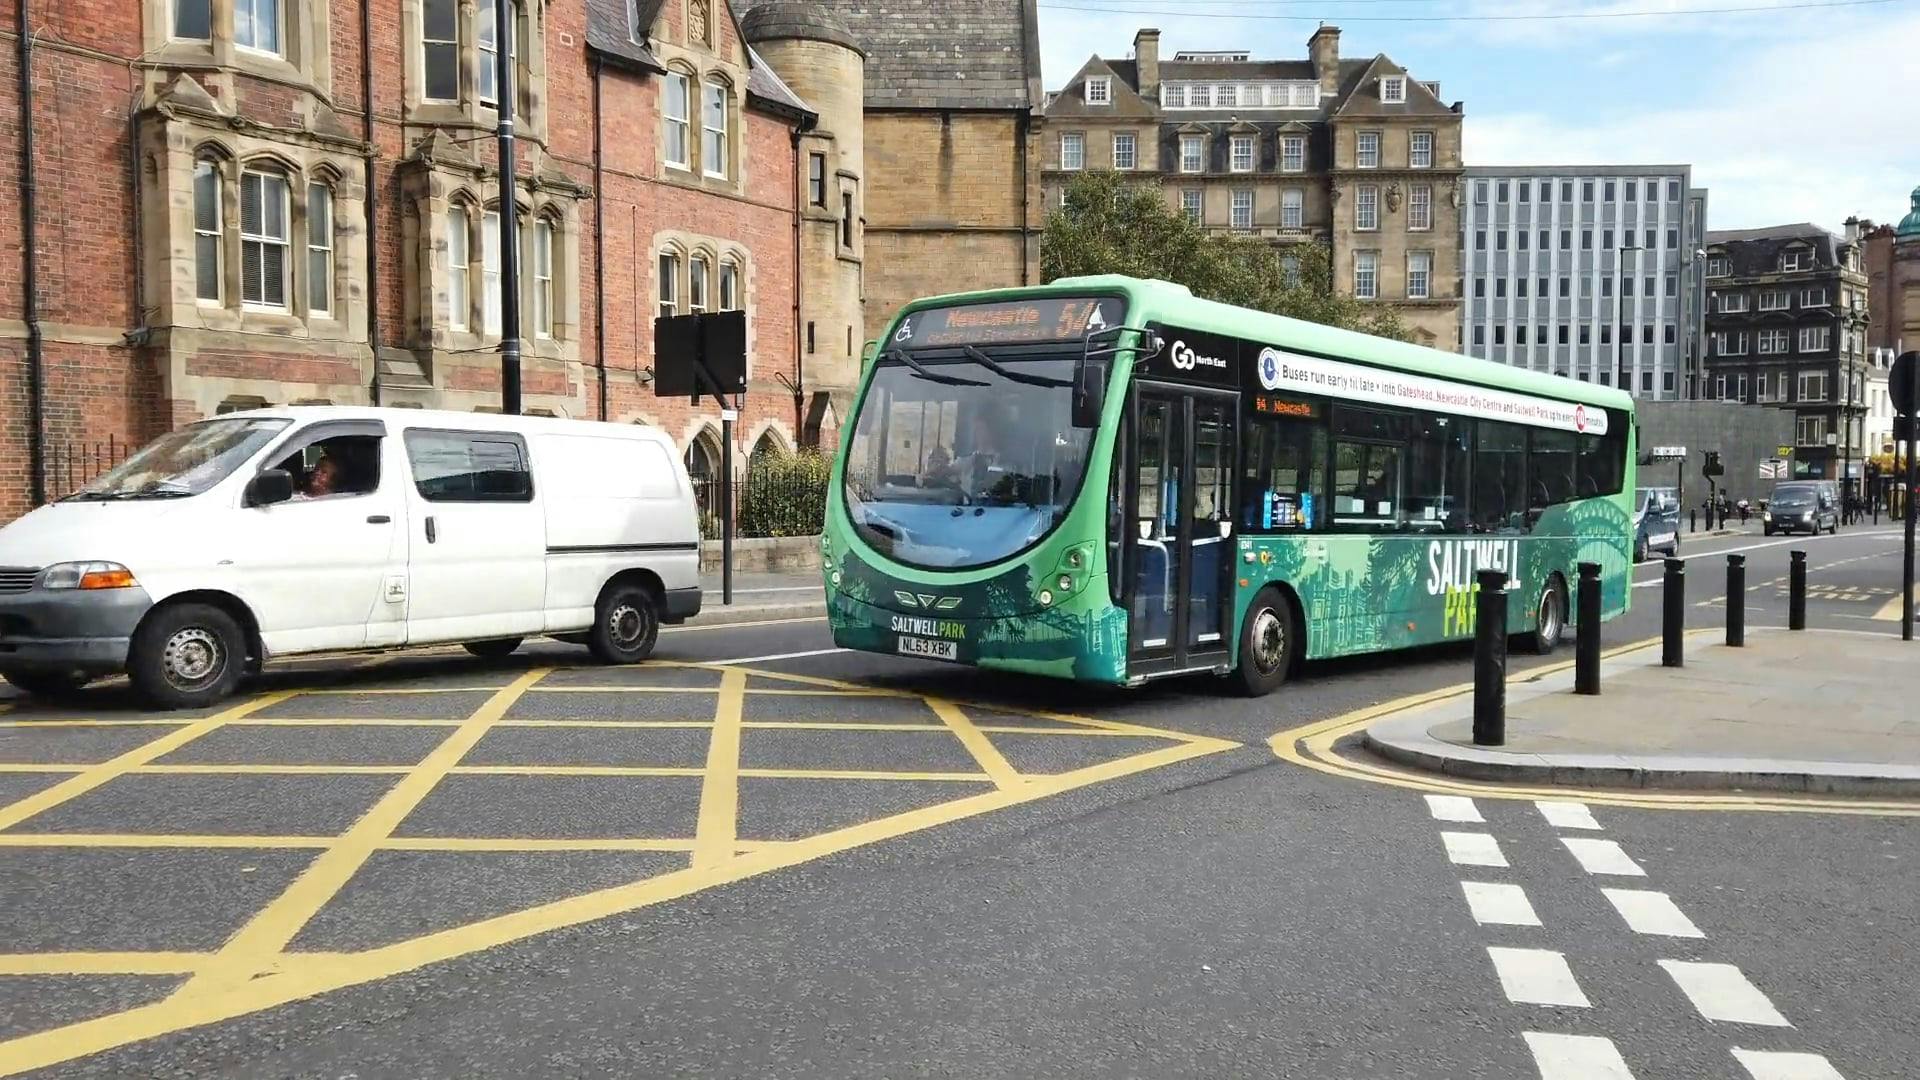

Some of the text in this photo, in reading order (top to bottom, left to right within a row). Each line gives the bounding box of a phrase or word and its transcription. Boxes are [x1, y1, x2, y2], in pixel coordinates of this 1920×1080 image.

[947, 308, 1040, 327] Newcastle
[1056, 302, 1095, 338] 54
[1196, 354, 1227, 369] North East
[1282, 365, 1309, 382] Buses
[1310, 371, 1326, 385] run
[1327, 374, 1348, 391] early
[1359, 378, 1374, 392] late
[1381, 383, 1396, 397] into
[1436, 390, 1469, 407] Newcastle
[1470, 395, 1481, 411] City
[1482, 398, 1502, 412] Centre
[1503, 403, 1513, 413] and
[1514, 403, 1536, 417] Saltwell
[1536, 406, 1549, 420] Park
[1586, 416, 1604, 427] minutes
[1274, 400, 1313, 417] Newcastle
[1427, 540, 1521, 595] SALTWELL
[891, 616, 966, 639] SALTWELL PARK
[903, 638, 952, 656] NL63 XBK
